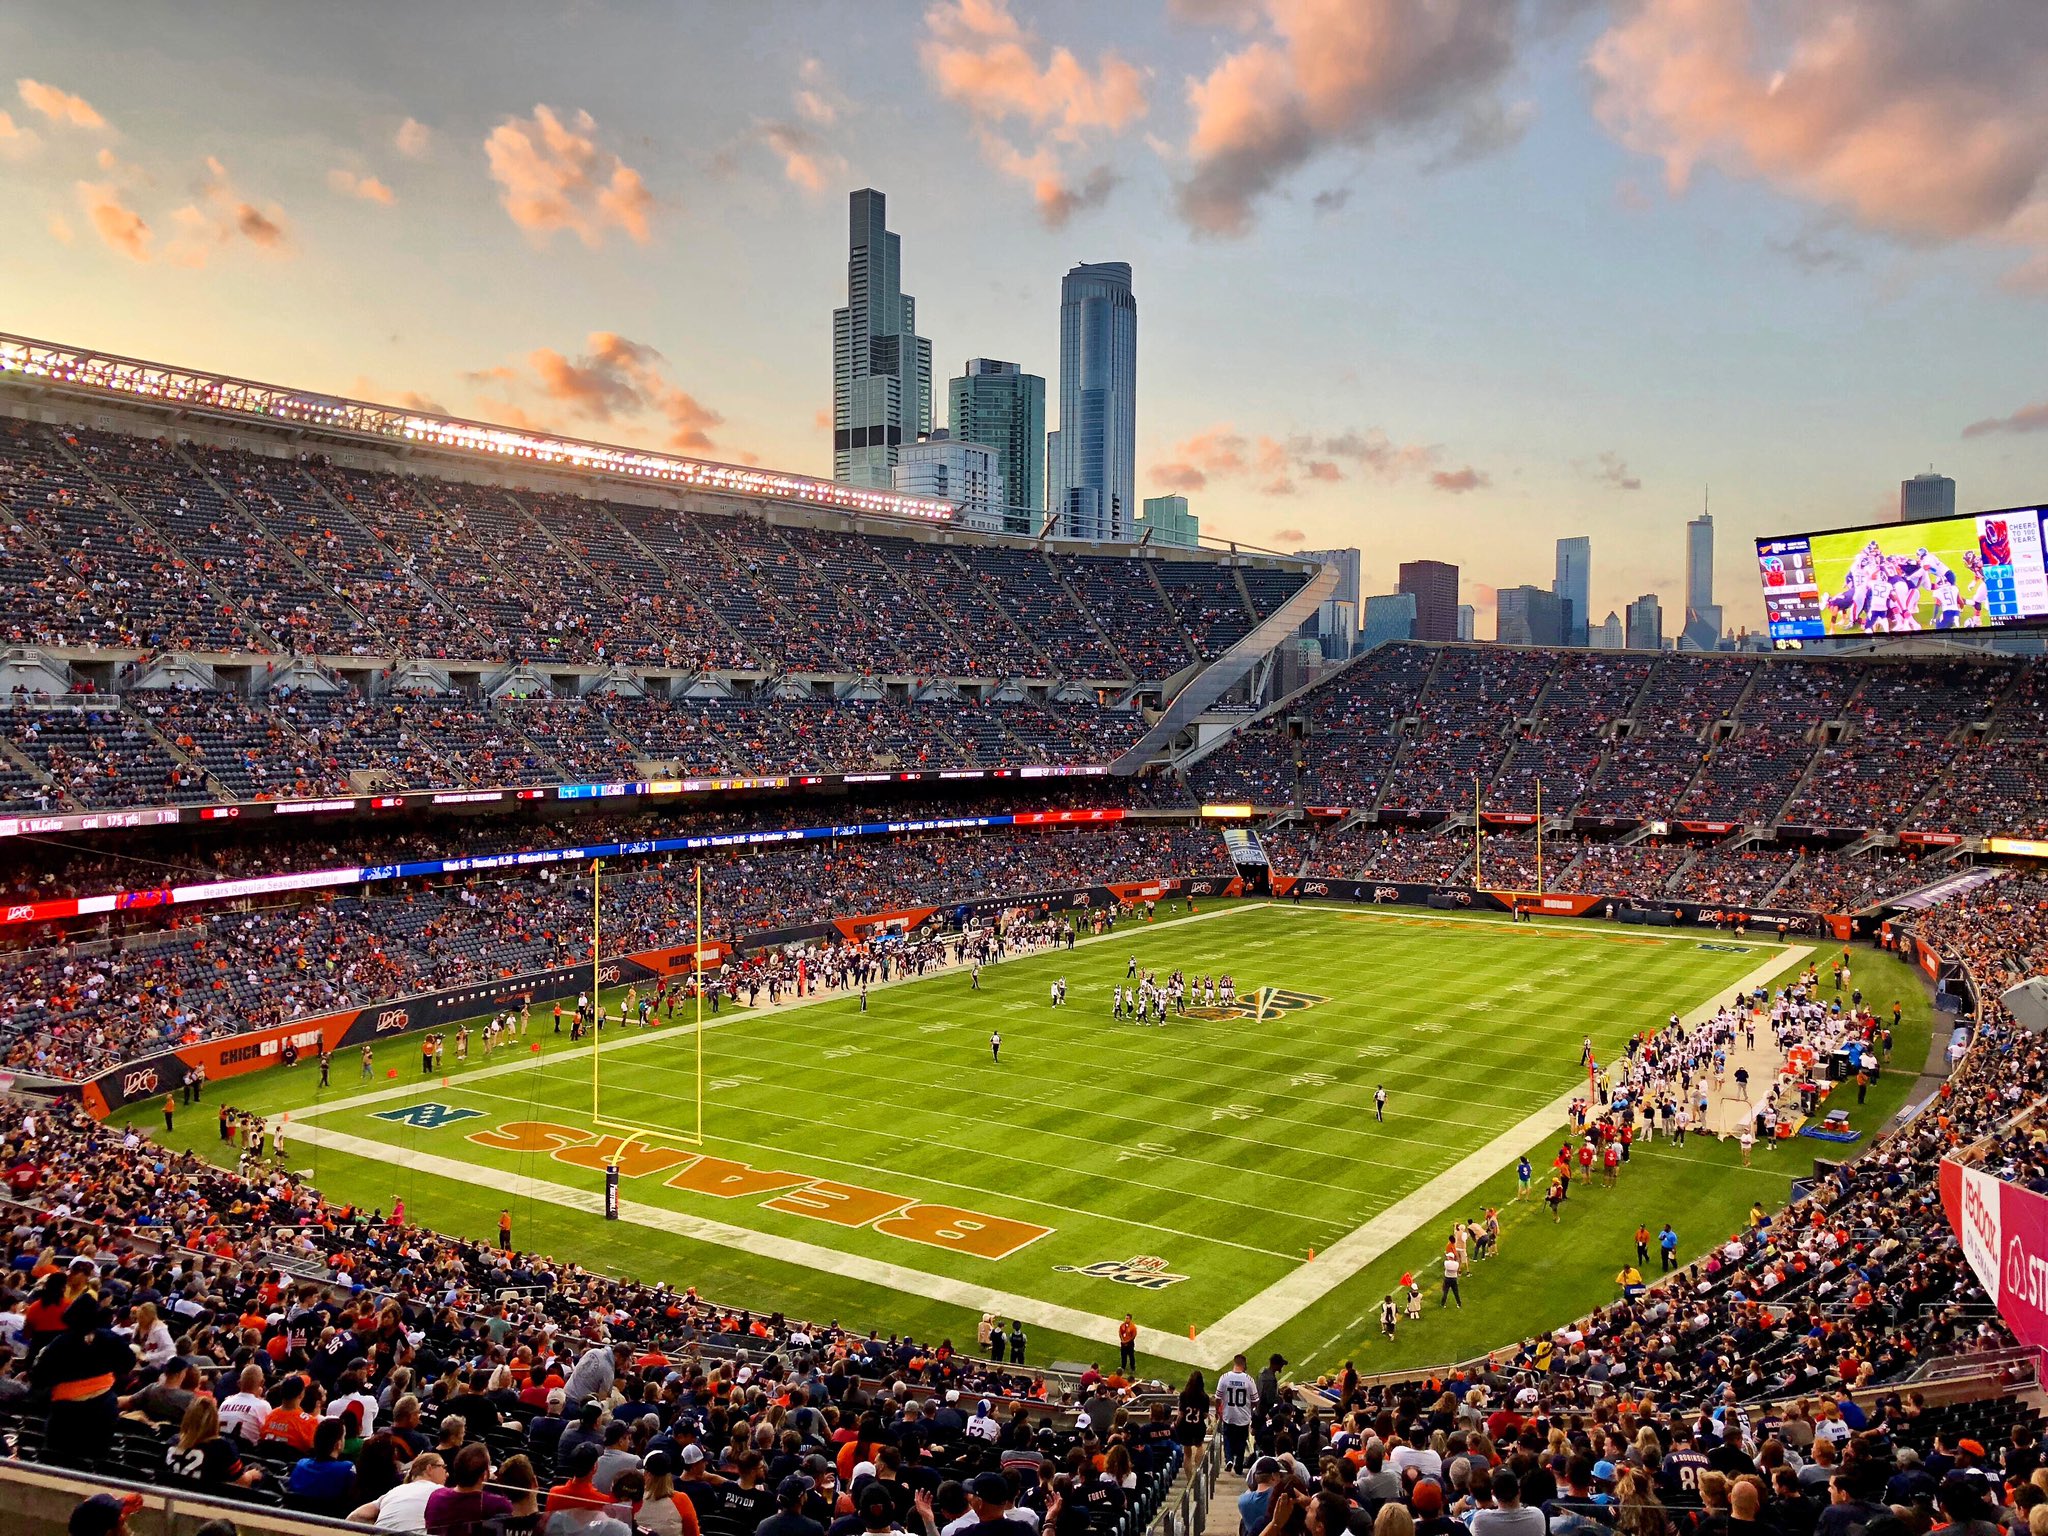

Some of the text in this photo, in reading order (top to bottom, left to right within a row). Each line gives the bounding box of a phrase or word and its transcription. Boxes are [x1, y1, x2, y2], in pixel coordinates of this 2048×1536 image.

[2009, 522, 2037, 531] CHEERS
[1793, 553, 1802, 568] 0
[1795, 569, 1804, 584] 0
[107, 815, 123, 826] 175
[203, 874, 339, 897] Bears Regular Season Schedule
[220, 1039, 278, 1066] CHICAGO
[464, 1121, 1057, 1261] BEARS
[295, 1327, 306, 1338] 34
[325, 1336, 344, 1355] 96
[1227, 1387, 1246, 1407] 10
[221, 1403, 252, 1414] URLACHER
[1185, 1406, 1200, 1423] 23
[1672, 1454, 1708, 1465] N.ROBINSON
[726, 1492, 754, 1507] PAYTON
[1088, 1489, 1107, 1502] FORTE
